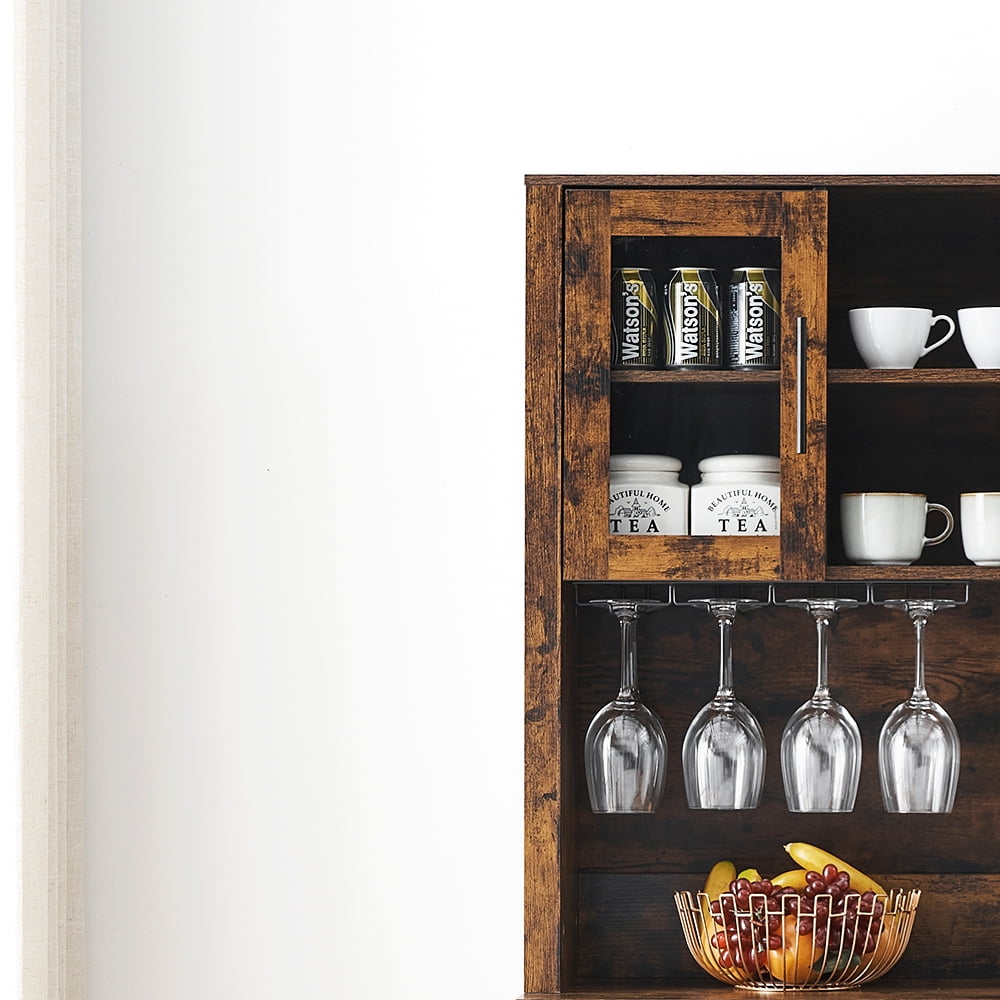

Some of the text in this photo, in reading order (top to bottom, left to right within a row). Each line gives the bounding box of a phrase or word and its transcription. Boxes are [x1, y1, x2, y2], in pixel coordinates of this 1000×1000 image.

[621, 282, 641, 361] Watson's
[681, 282, 699, 361] Watson's
[745, 282, 764, 361] Watson's
[609, 489, 671, 513] AUTIFUL HOME
[707, 489, 779, 513] BEAUTIFUL HOME
[610, 518, 660, 533] TEA
[718, 518, 768, 533] TEA
